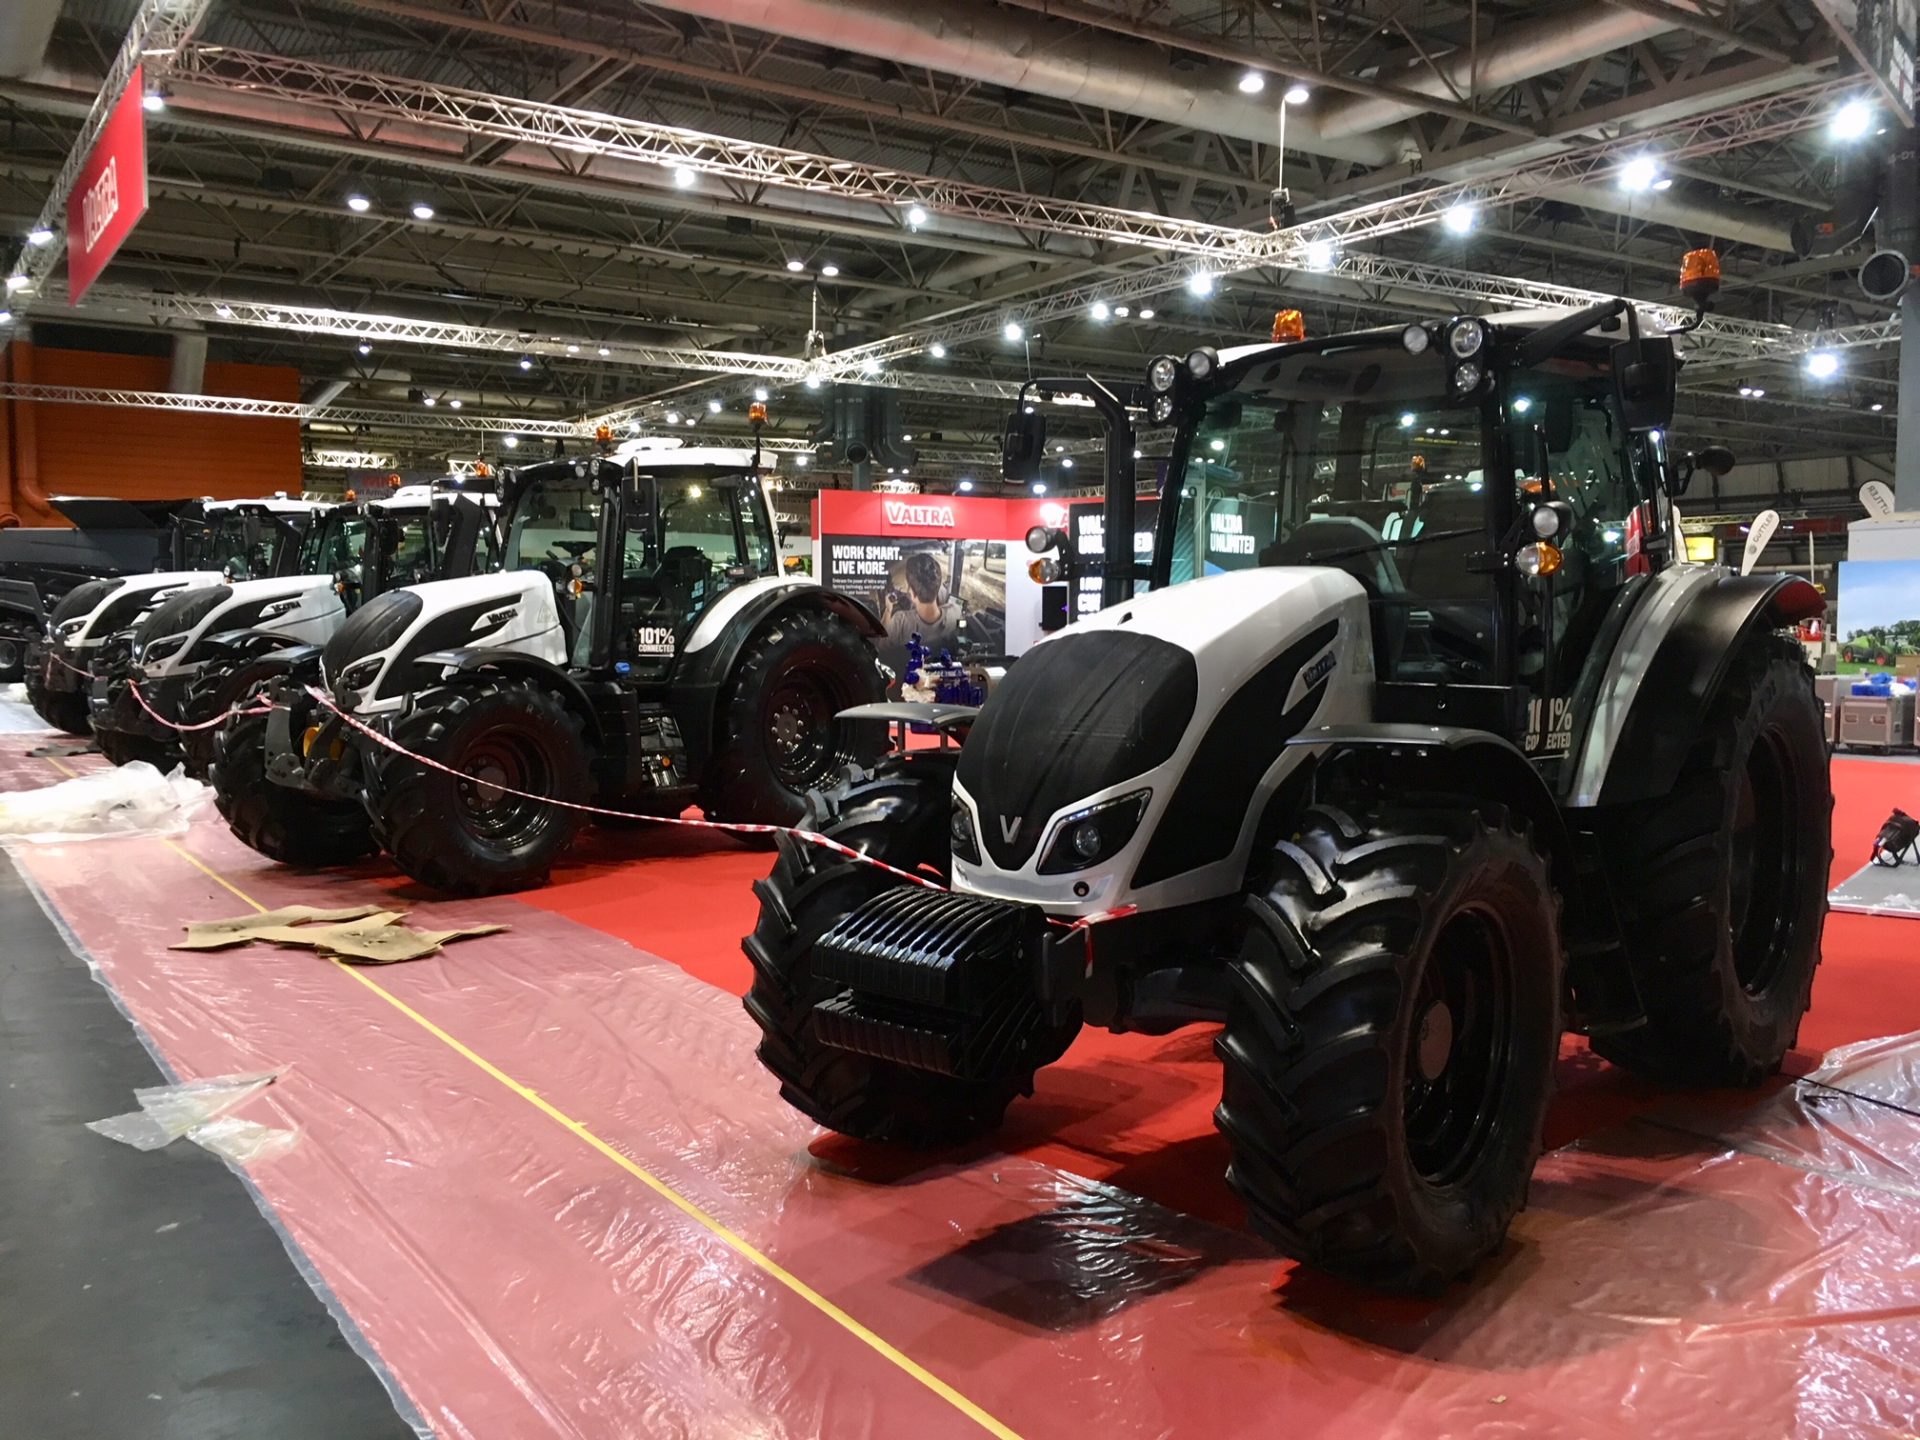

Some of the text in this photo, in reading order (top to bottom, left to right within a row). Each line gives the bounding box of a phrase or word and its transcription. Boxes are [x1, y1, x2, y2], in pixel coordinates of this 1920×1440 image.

[884, 500, 955, 527] VALTRA
[1210, 512, 1243, 535] VALTRA
[832, 544, 903, 561] WORK SMART.
[1210, 532, 1255, 555] UNLIMITED
[832, 560, 889, 575] LIVE MORE.
[638, 627, 675, 645] 101%
[638, 644, 675, 653] CONNECTED
[1525, 731, 1572, 751] COECTED
